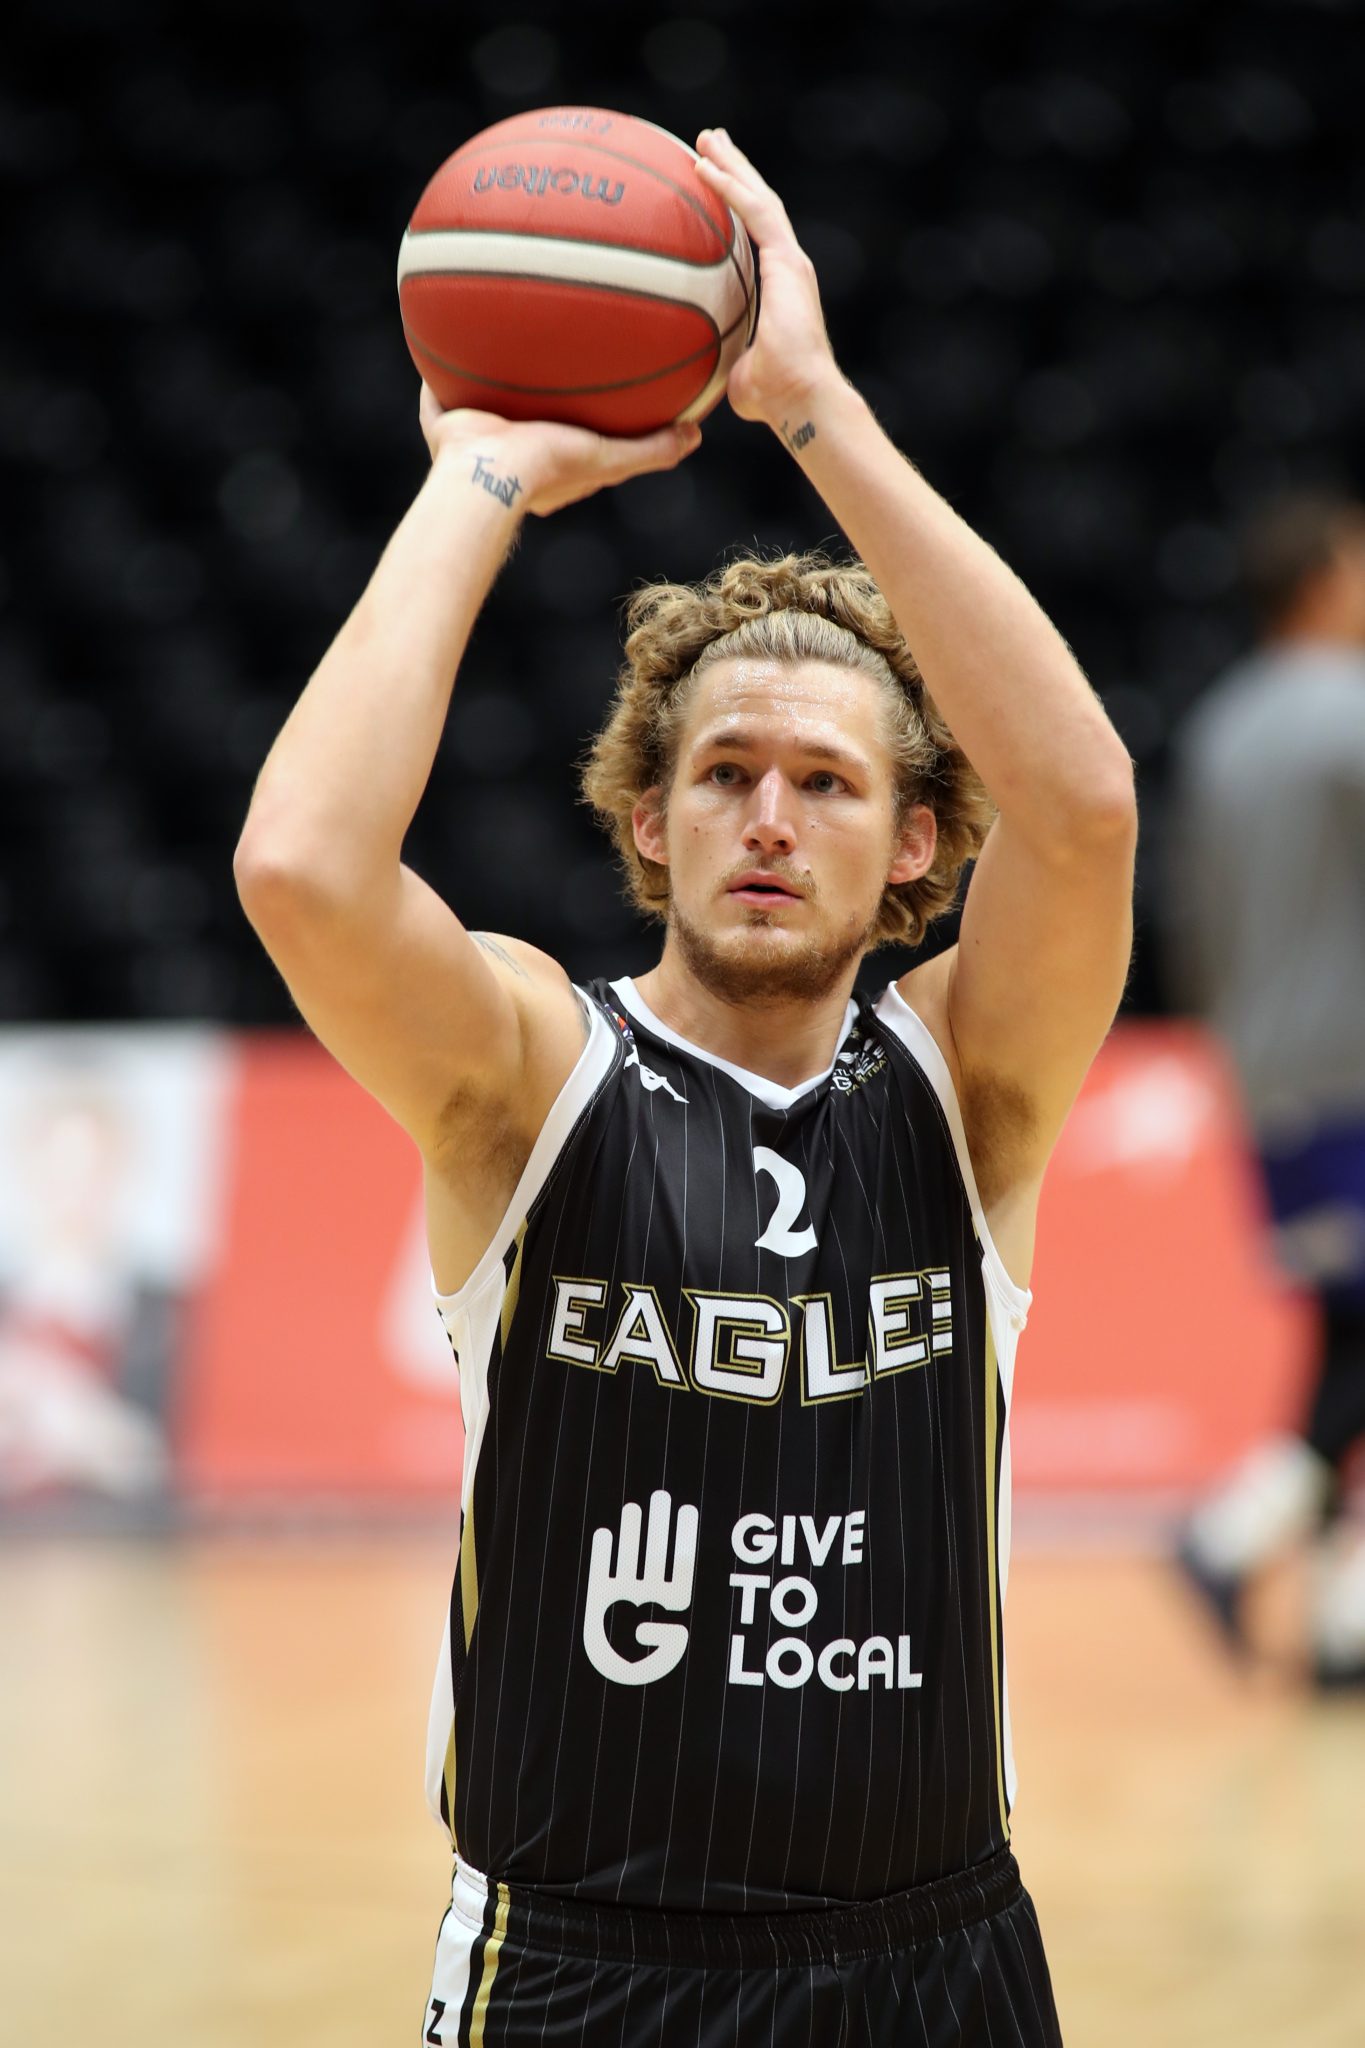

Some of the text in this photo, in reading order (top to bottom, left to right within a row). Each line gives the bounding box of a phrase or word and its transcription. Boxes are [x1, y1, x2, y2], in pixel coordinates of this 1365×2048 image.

[473, 164, 627, 208] molten
[471, 455, 523, 509] Trust
[753, 1145, 819, 1259] 2
[730, 1509, 866, 1567] GIVE
[728, 1573, 819, 1629] TO
[727, 1634, 924, 1693] LOCAL
